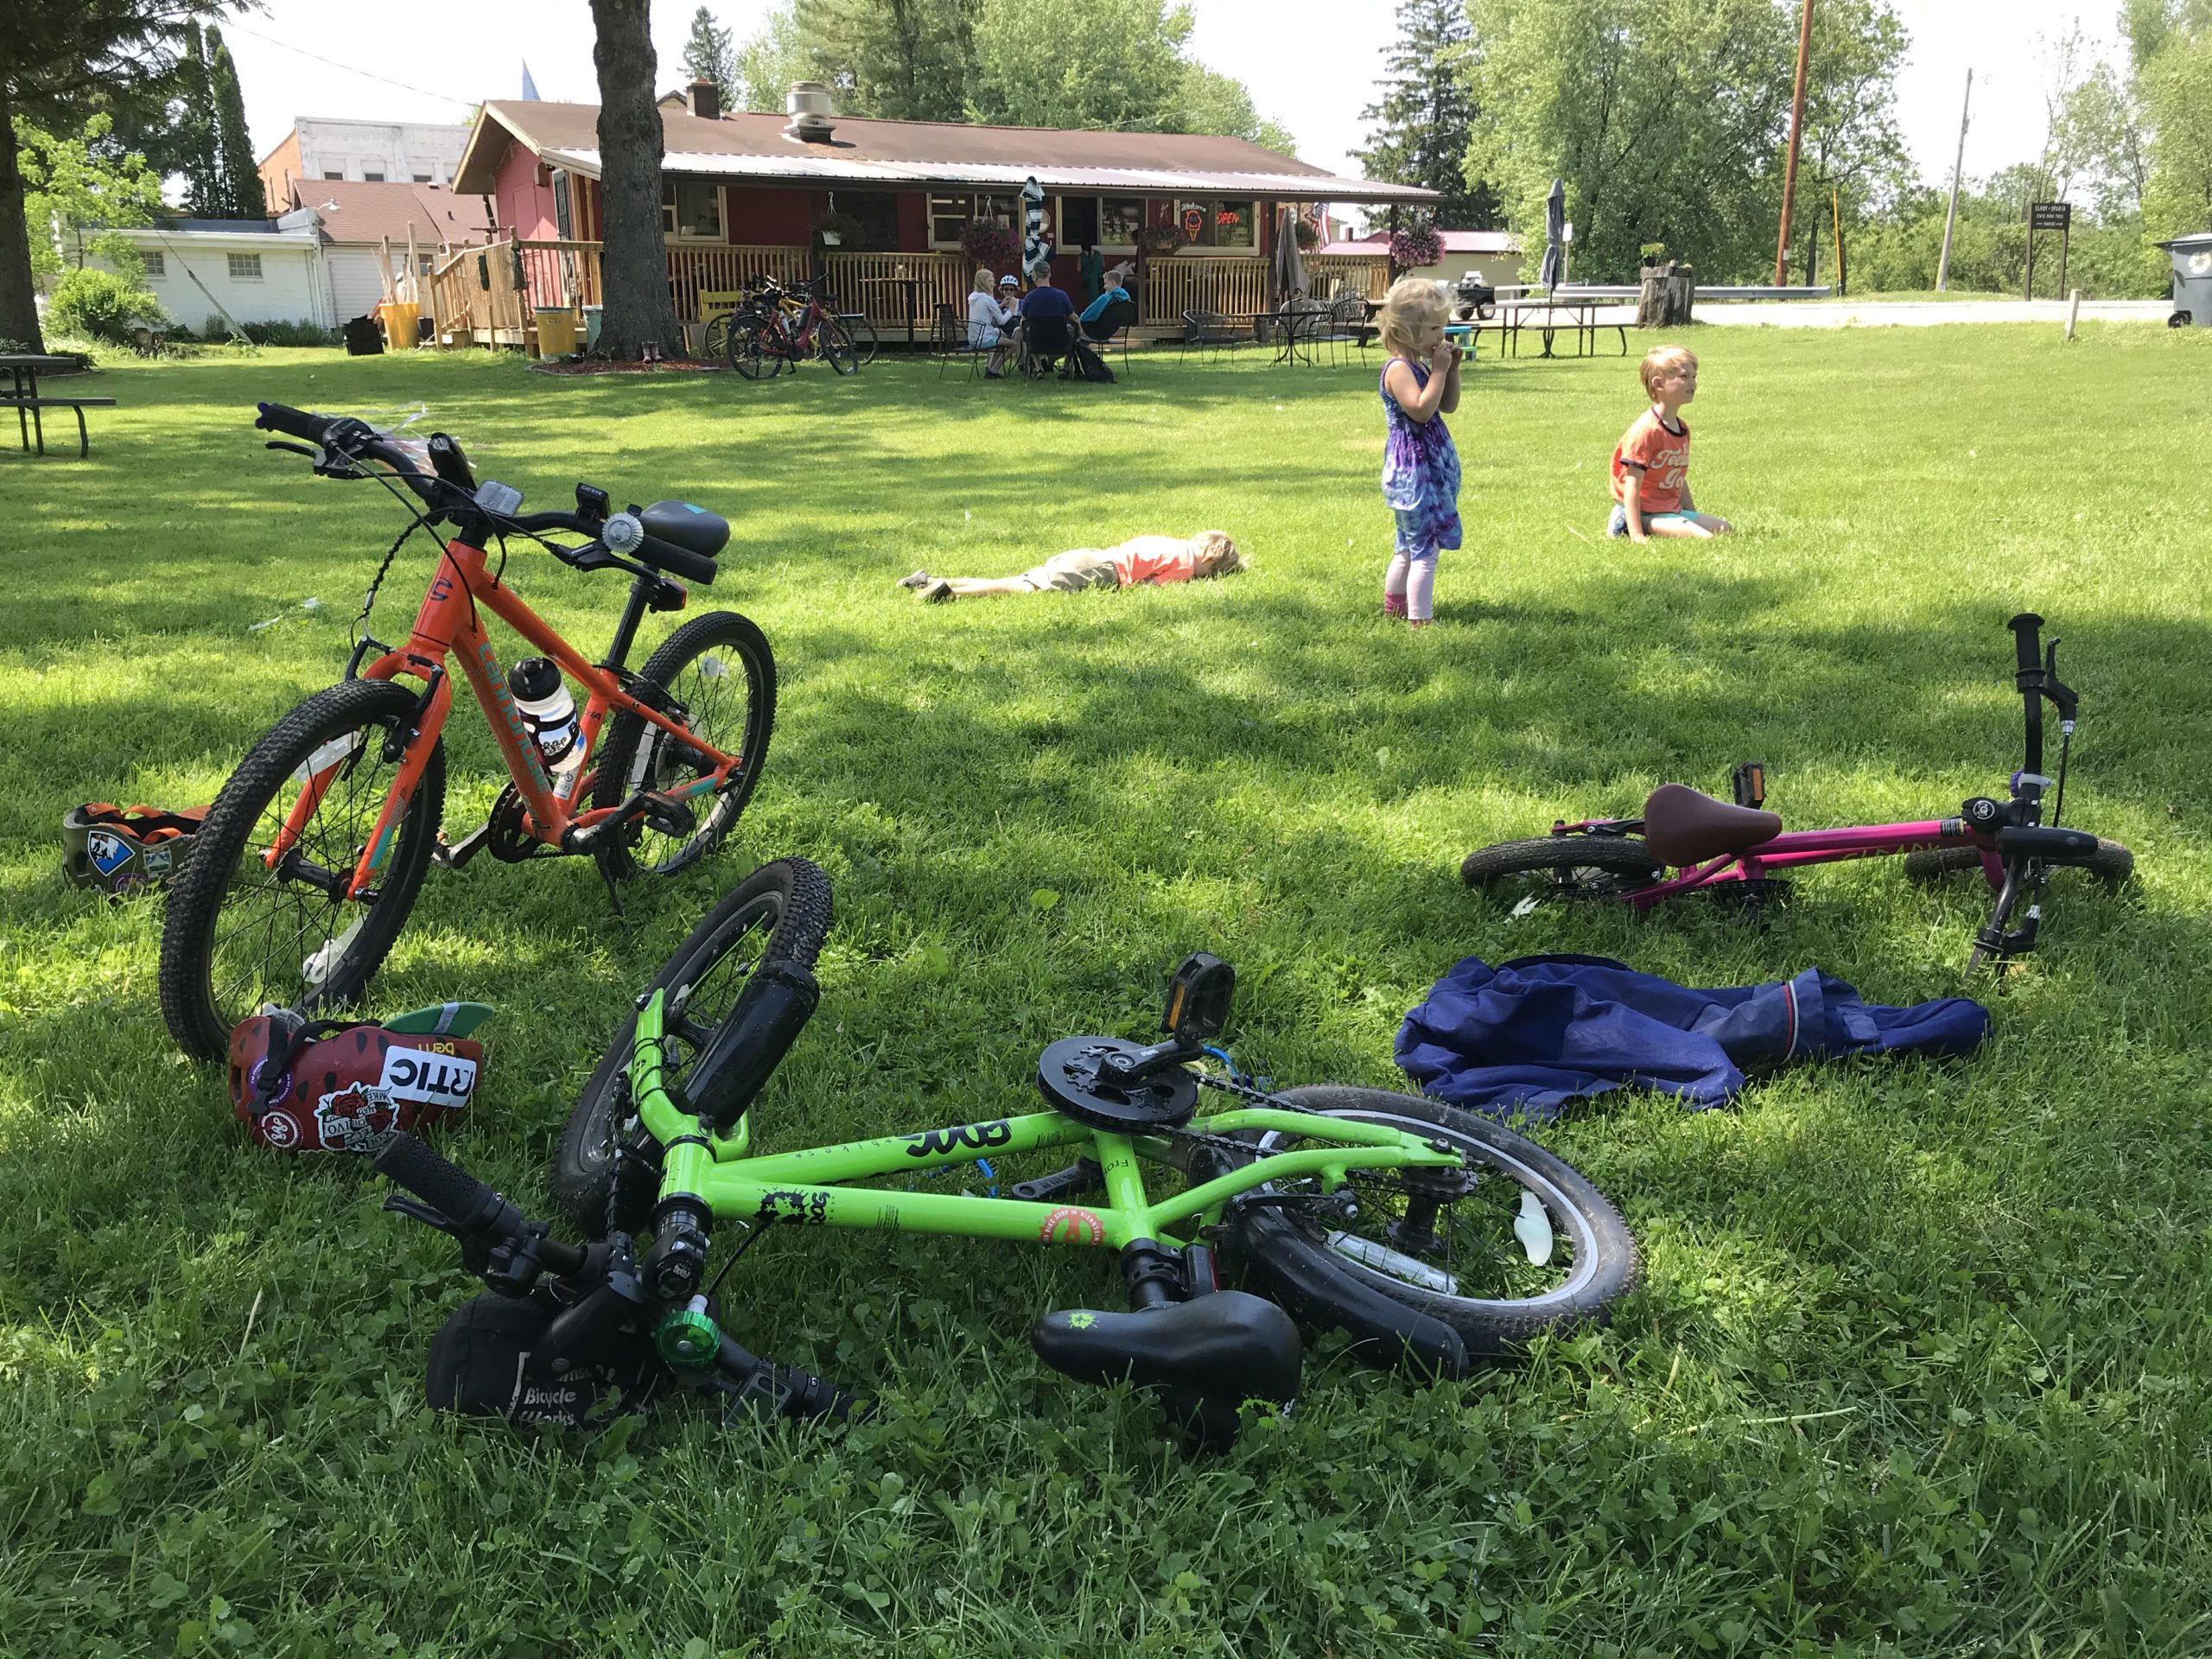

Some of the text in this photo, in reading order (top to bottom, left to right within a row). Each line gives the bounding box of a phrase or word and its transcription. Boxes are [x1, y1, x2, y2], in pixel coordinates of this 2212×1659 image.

[1217, 212, 1239, 225] OPEN
[581, 485, 602, 495] CATEYE
[389, 1058, 474, 1096] RTIC
[524, 1388, 577, 1408] Bicycle
